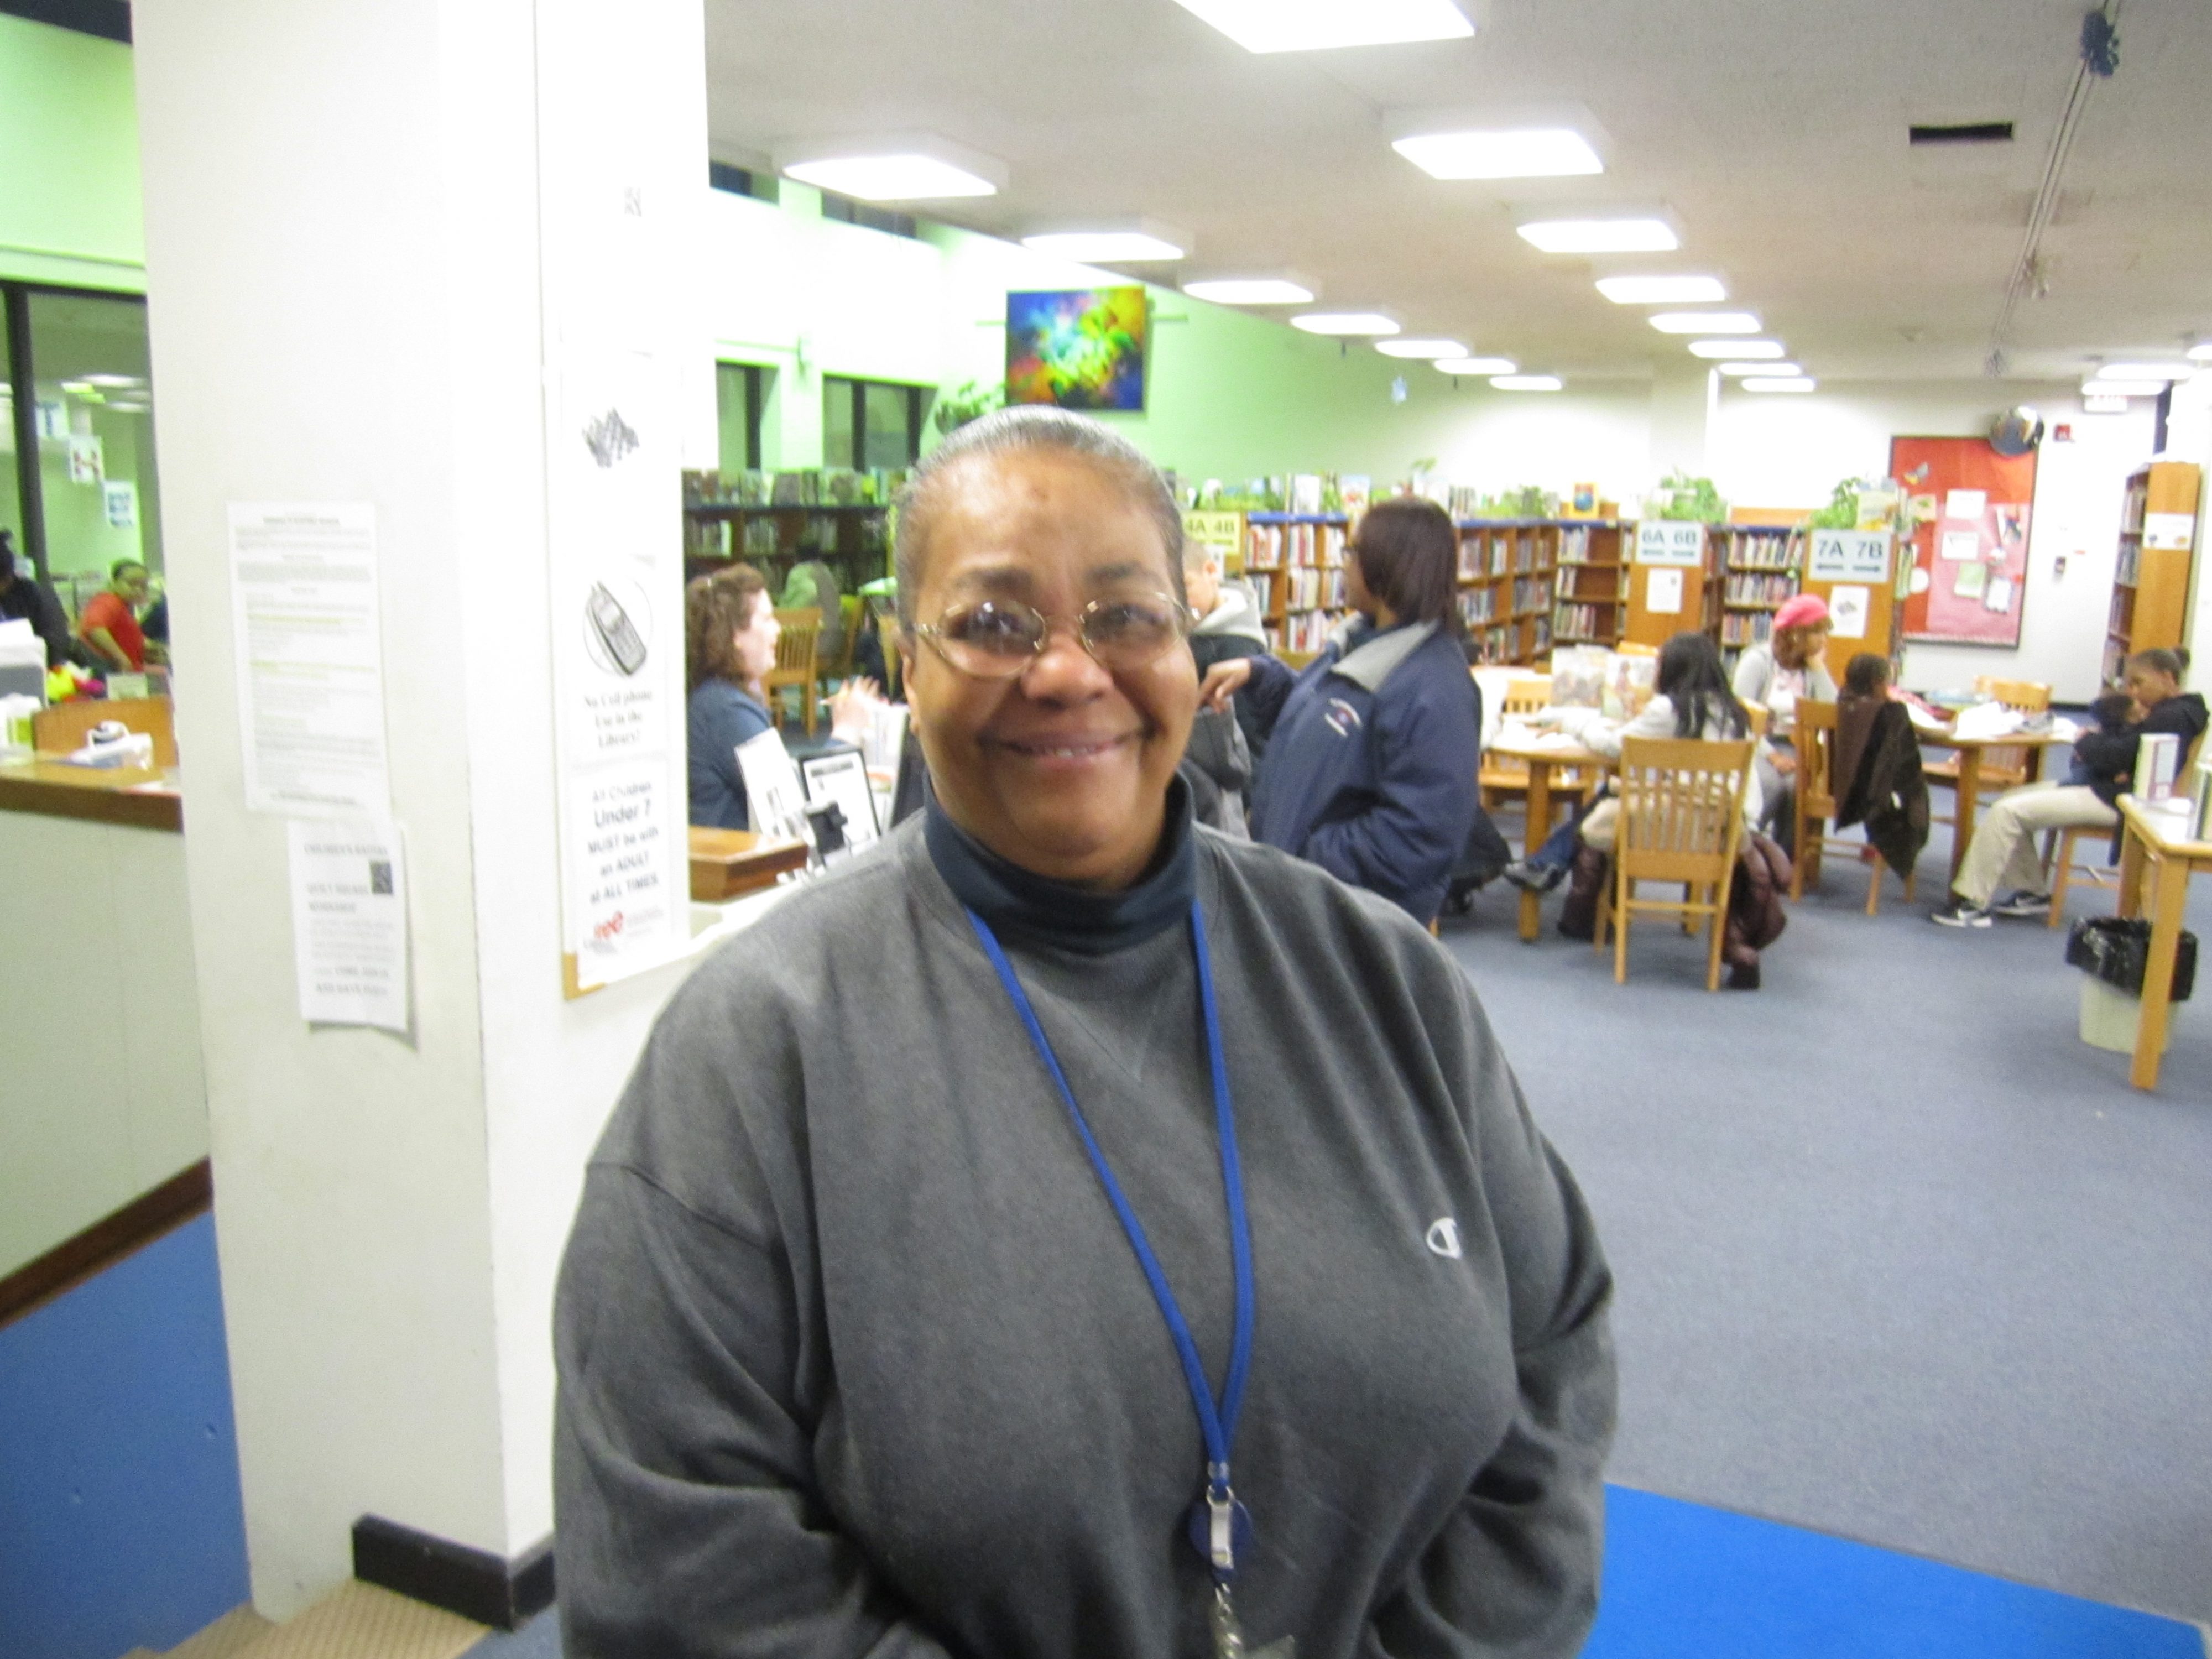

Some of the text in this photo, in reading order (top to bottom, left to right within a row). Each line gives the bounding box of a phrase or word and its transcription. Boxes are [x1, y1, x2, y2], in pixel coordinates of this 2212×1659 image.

[1641, 528, 1697, 544] 6A 6B
[1818, 539, 1882, 558] 7A 7B
[623, 690, 653, 706] phone
[628, 708, 643, 723] the
[609, 781, 651, 801] Children
[594, 804, 638, 828] Under
[588, 826, 659, 854] MUST be with
[601, 850, 649, 877] an ADULT
[590, 889, 601, 904] at
[603, 884, 622, 899] ALL
